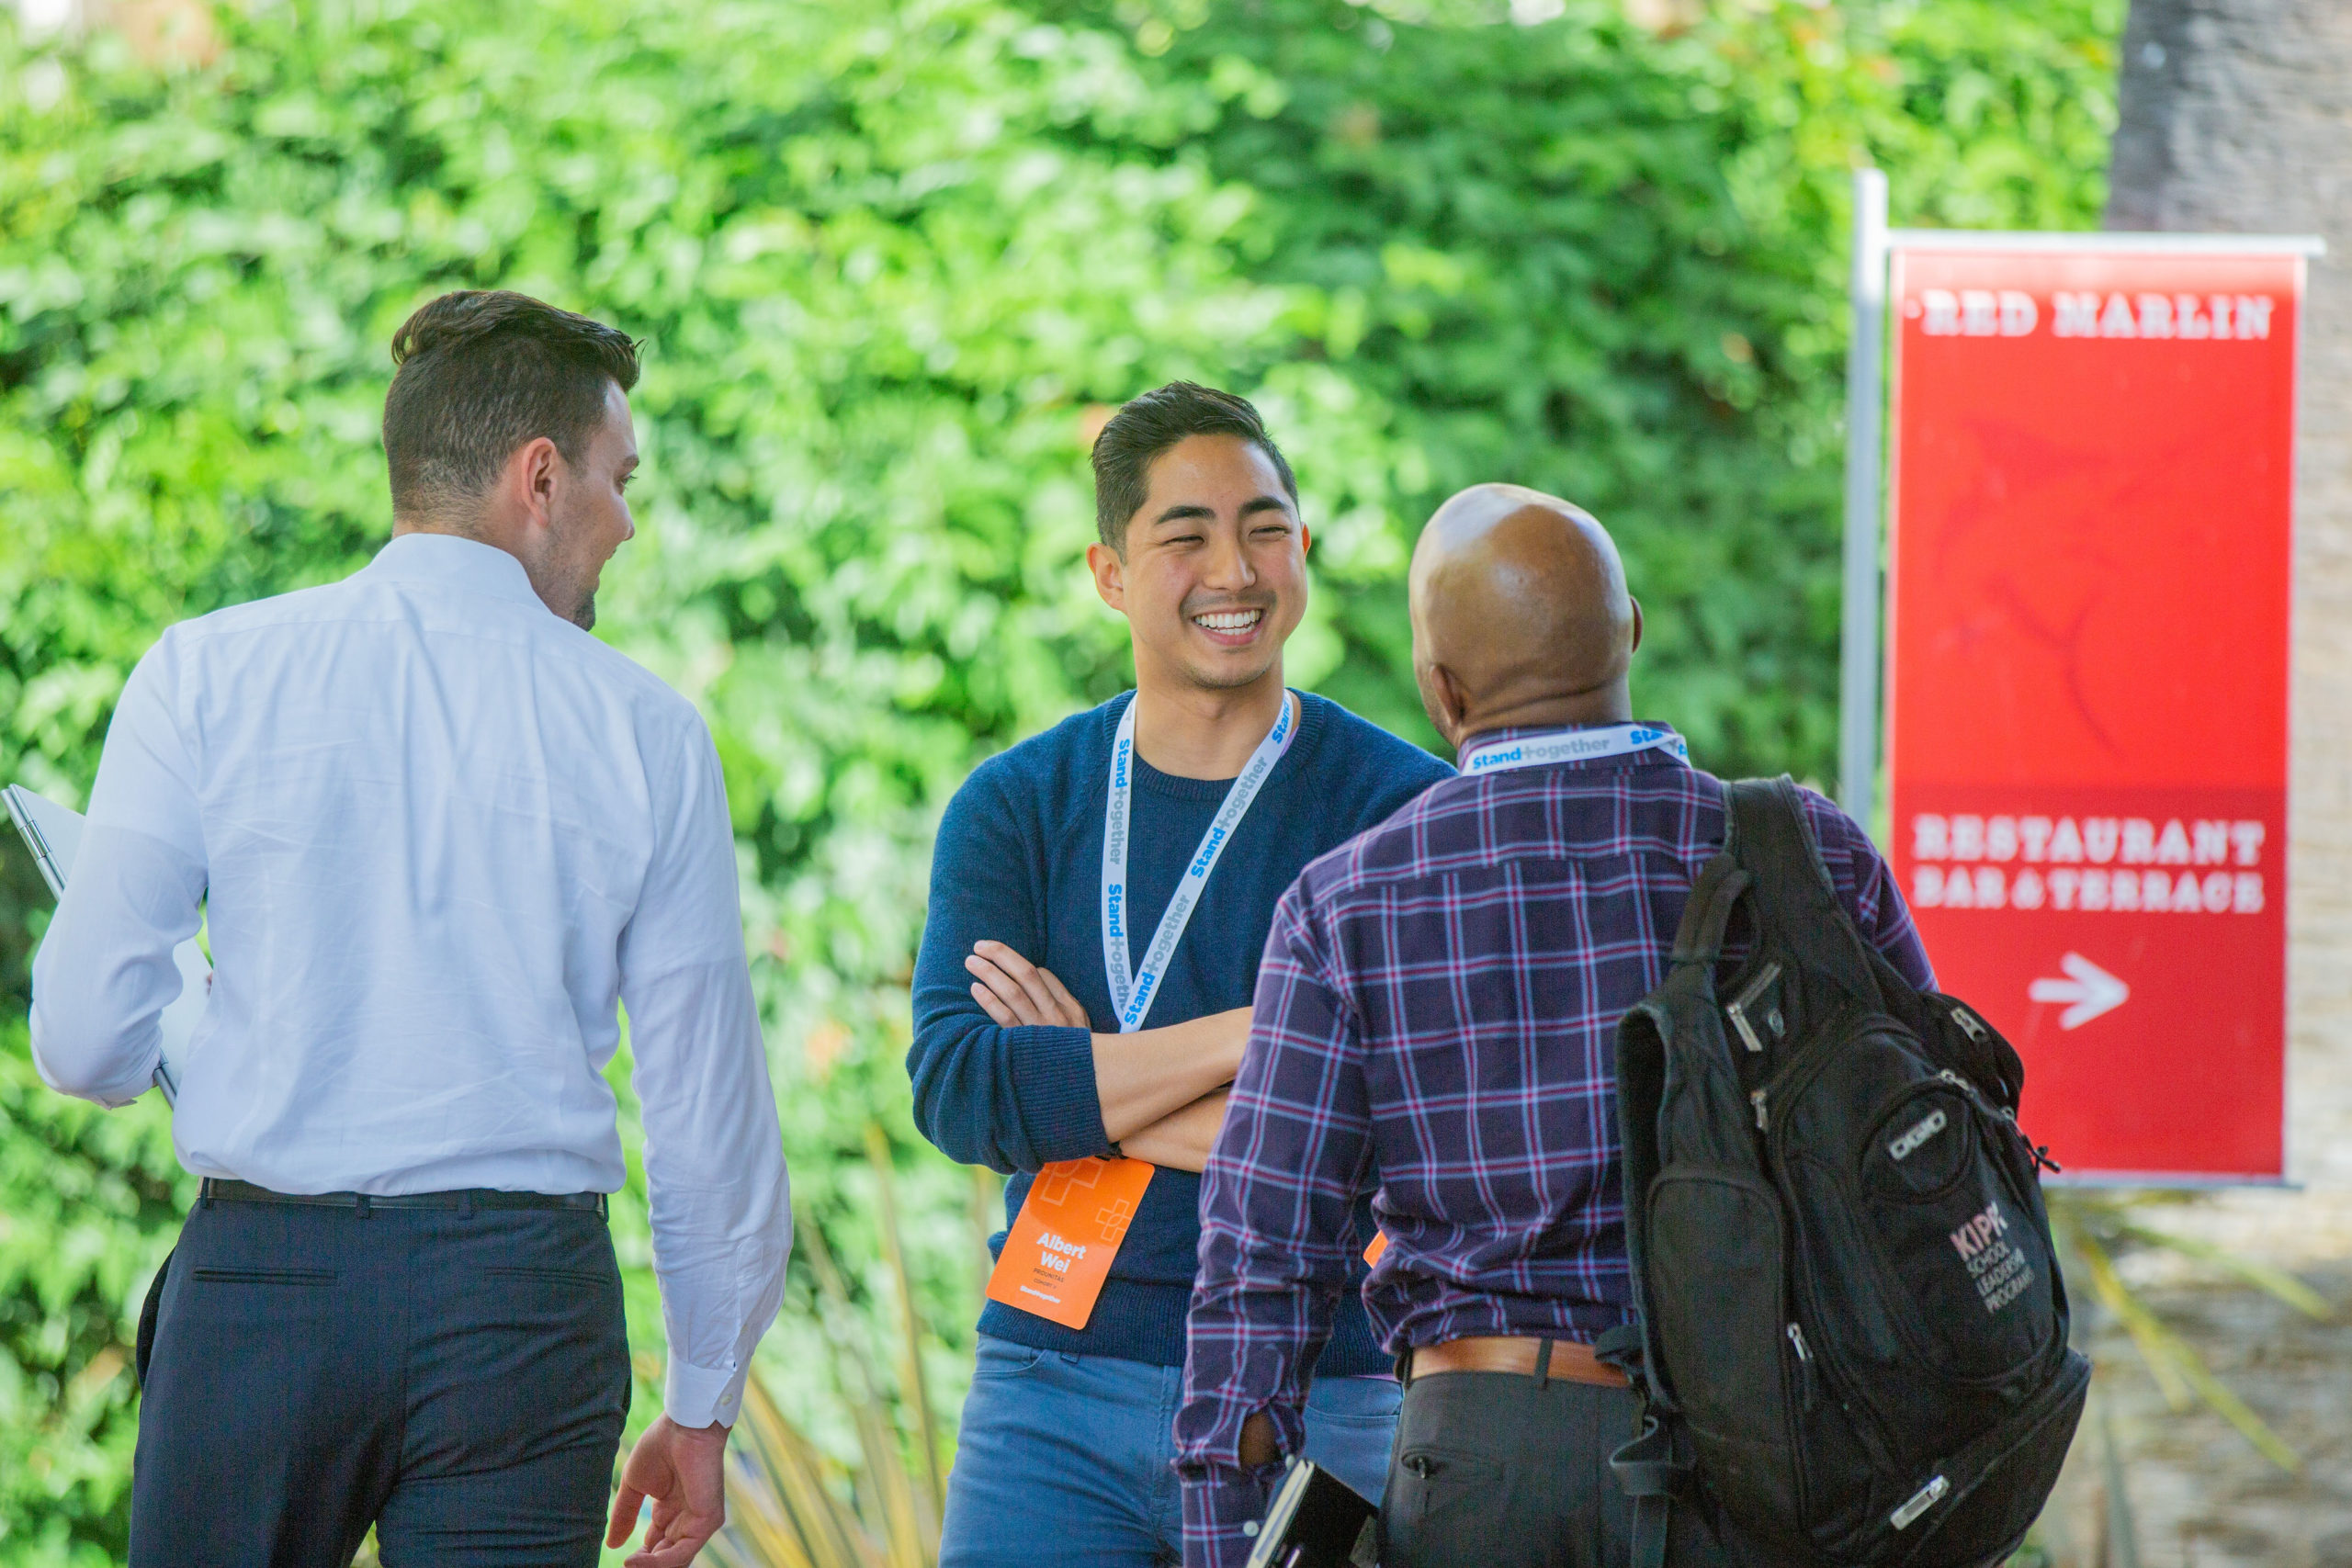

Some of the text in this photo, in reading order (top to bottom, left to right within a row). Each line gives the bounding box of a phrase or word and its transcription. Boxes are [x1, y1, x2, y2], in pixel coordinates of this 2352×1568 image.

[1921, 289, 2274, 340] RED MARLIN
[1913, 813, 2266, 865] RESTAURANT
[1912, 865, 2007, 909] BAR
[2047, 868, 2266, 914] TERRACE
[1889, 1109, 1947, 1161] OGIO
[1036, 1232, 1086, 1259] Albert
[1040, 1250, 1071, 1273] Wei
